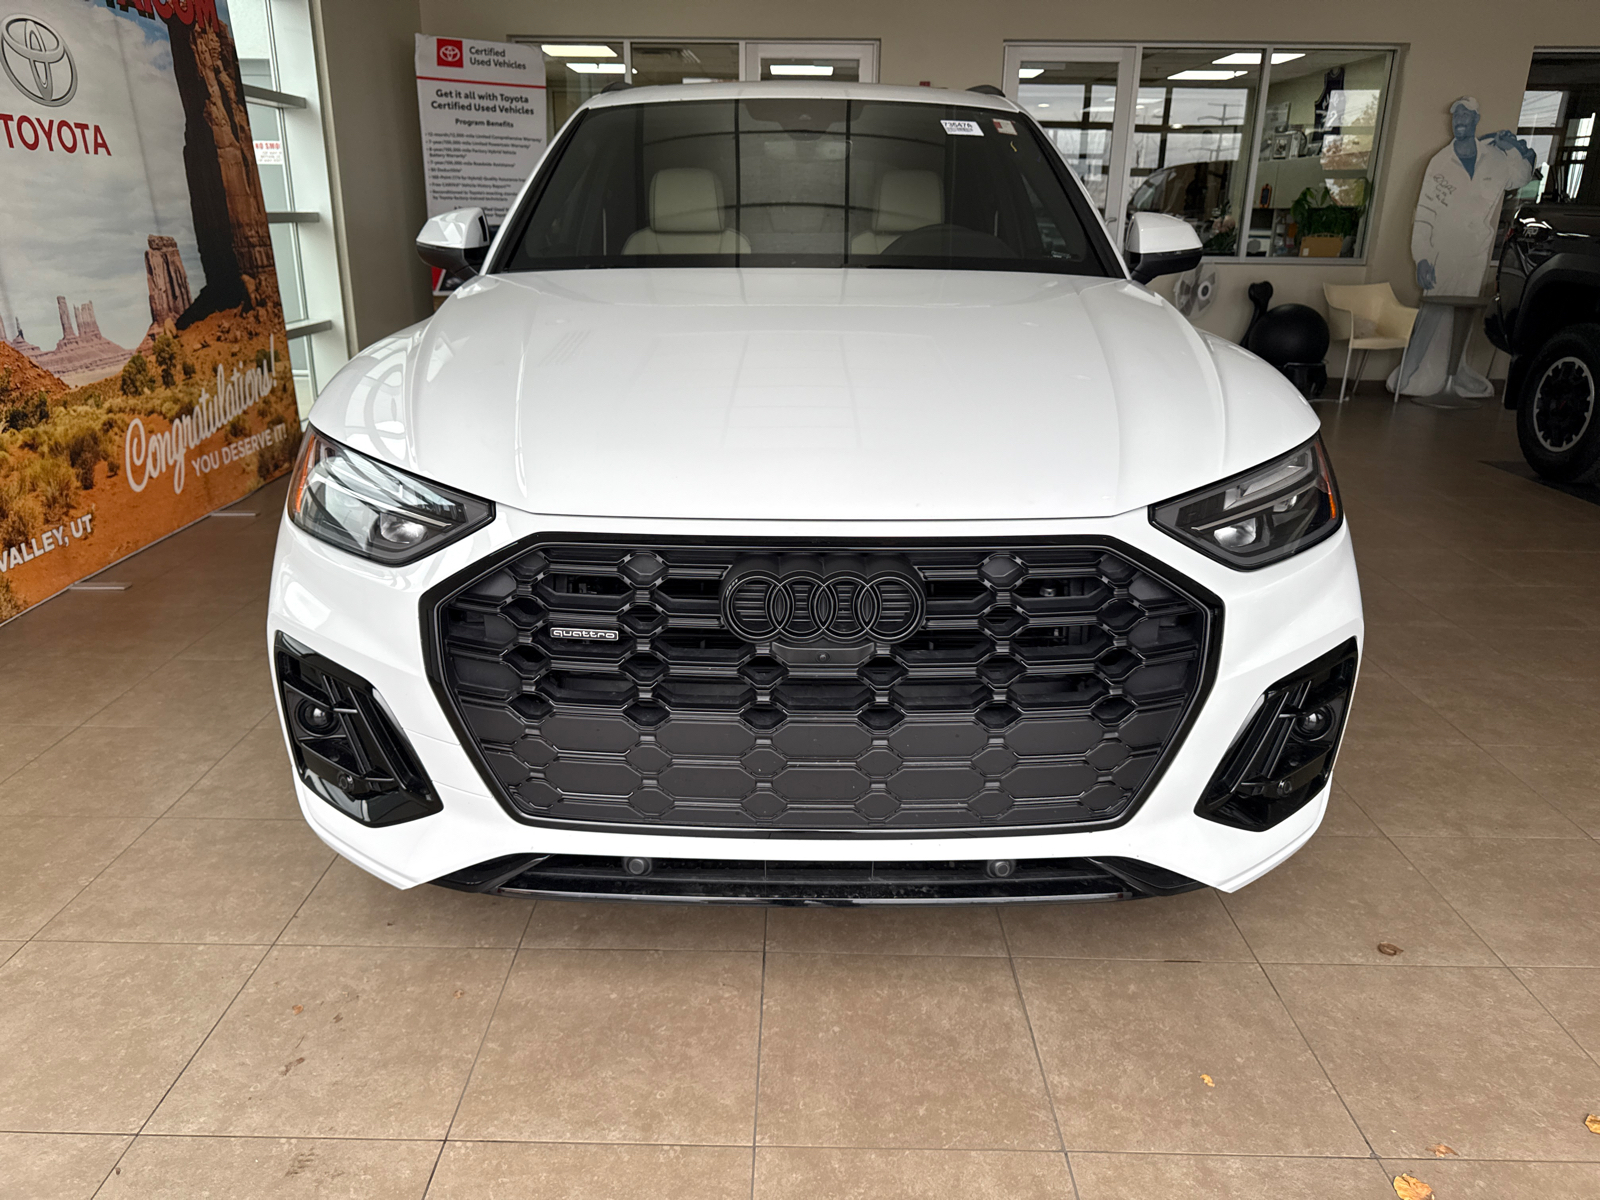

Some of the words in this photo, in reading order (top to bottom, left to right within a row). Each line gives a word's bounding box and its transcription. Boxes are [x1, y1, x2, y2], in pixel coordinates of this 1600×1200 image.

[469, 46, 505, 57] Certified
[470, 57, 491, 66] Used
[493, 59, 526, 70] Vehicles
[436, 89, 453, 98] Get
[455, 90, 462, 99] it
[464, 91, 476, 100] all
[478, 92, 498, 102] with
[499, 94, 529, 106] Toyota
[430, 100, 472, 112] Certified
[474, 103, 497, 112] Used
[498, 105, 534, 116] Vehicles
[455, 118, 485, 127] Program
[486, 119, 514, 128] Benefits
[0, 112, 112, 157] TOYOTA
[125, 333, 277, 494] Congratulations!
[192, 455, 220, 476] YOU
[222, 430, 272, 464] DESERVE
[274, 423, 288, 442] IT!
[0, 526, 69, 573] VALLEY,
[70, 514, 92, 538] UT
[553, 630, 615, 638] quattro
